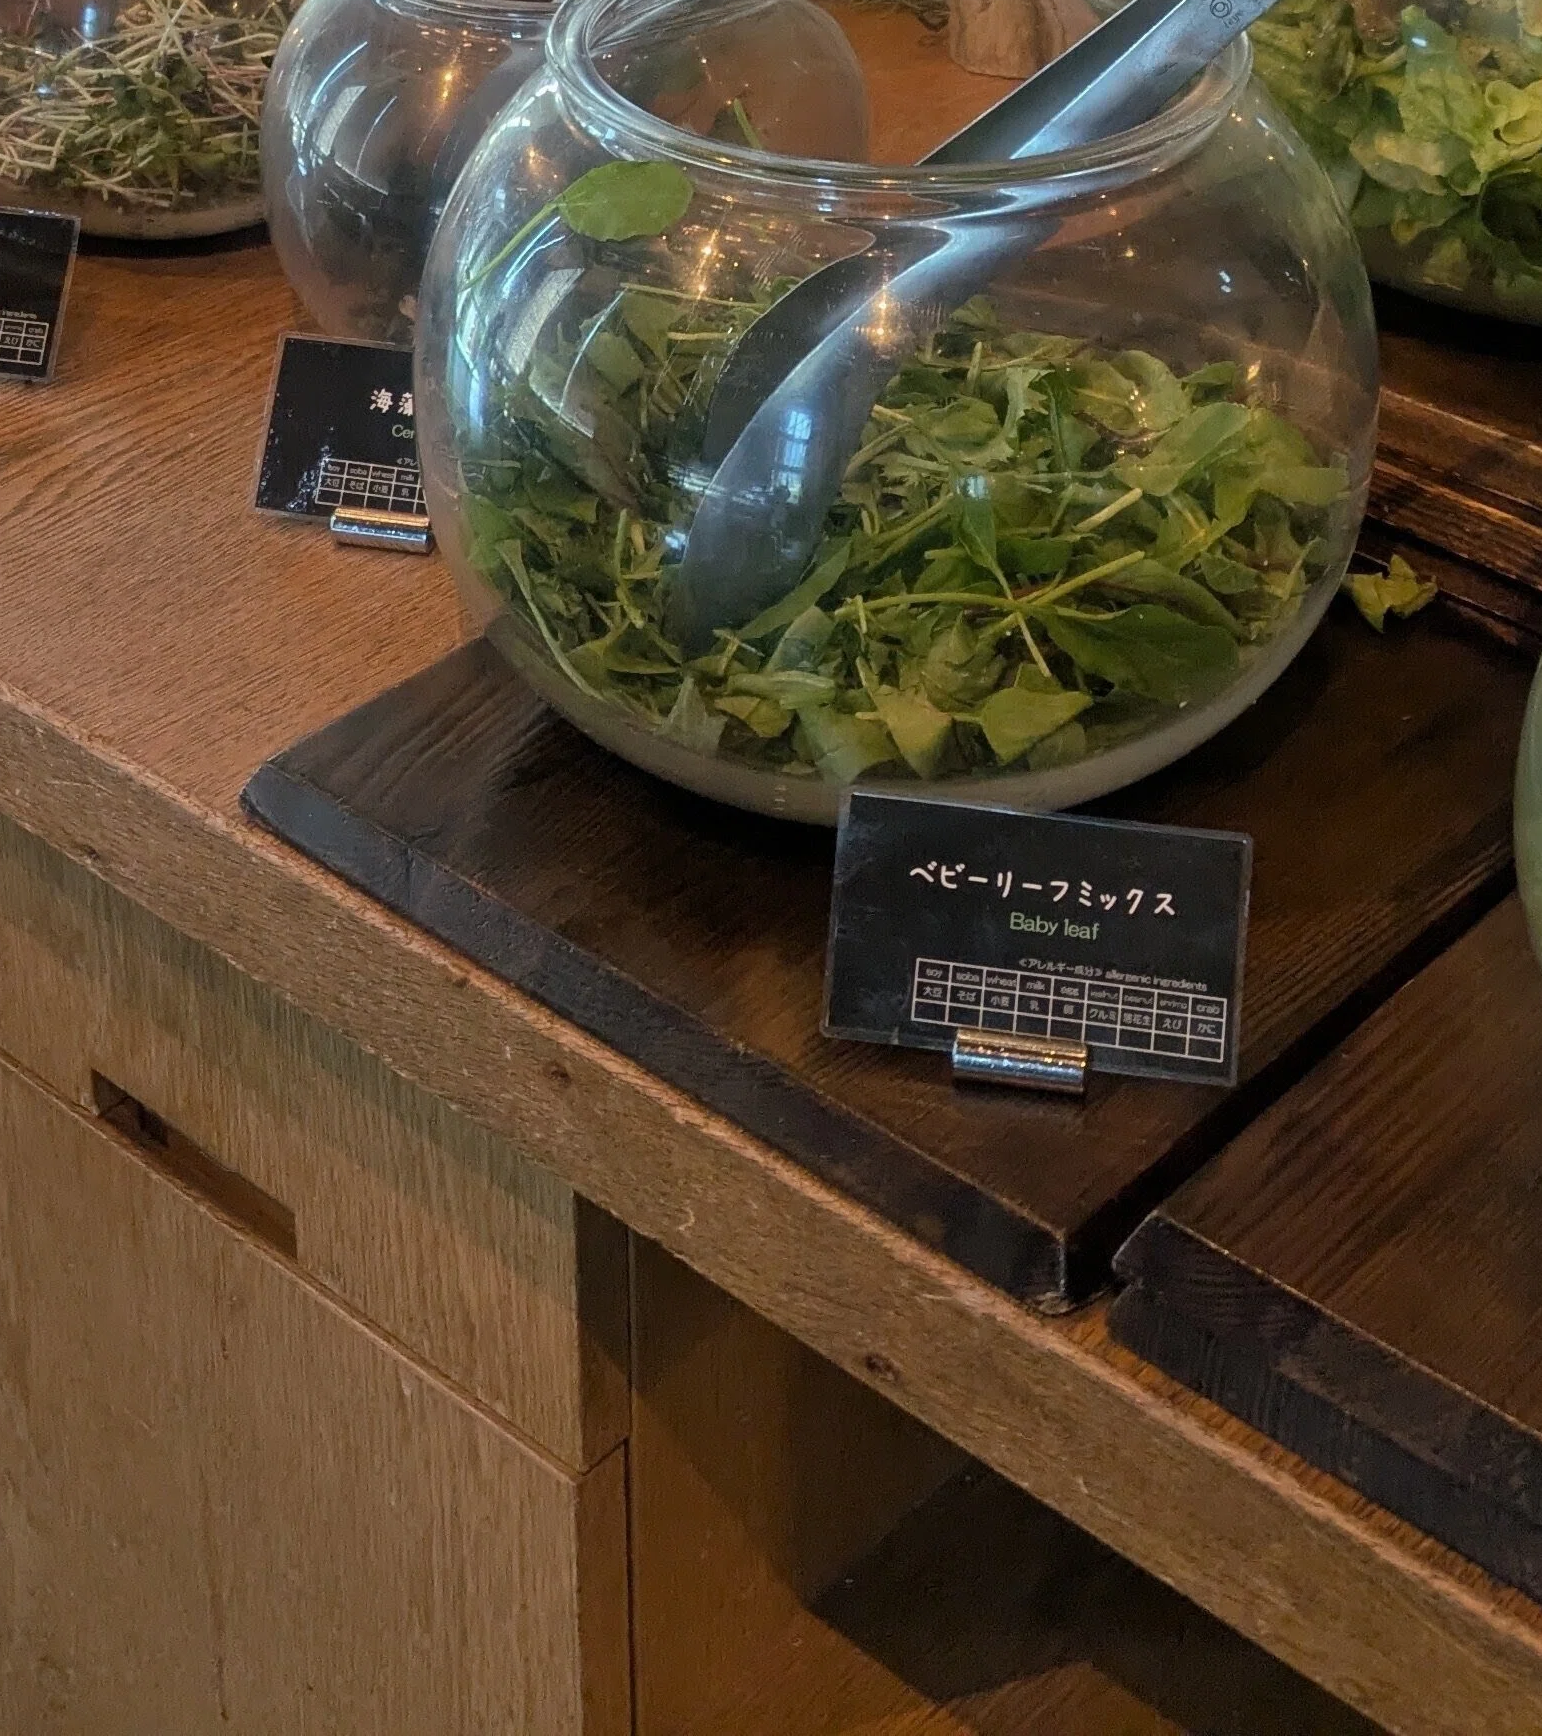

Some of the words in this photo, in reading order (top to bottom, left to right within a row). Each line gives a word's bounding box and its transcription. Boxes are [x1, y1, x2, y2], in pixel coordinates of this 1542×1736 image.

[909, 860, 1176, 917] ベビーリーフミックス
[1009, 912, 1059, 937] Baby
[1063, 918, 1100, 940] leaf
